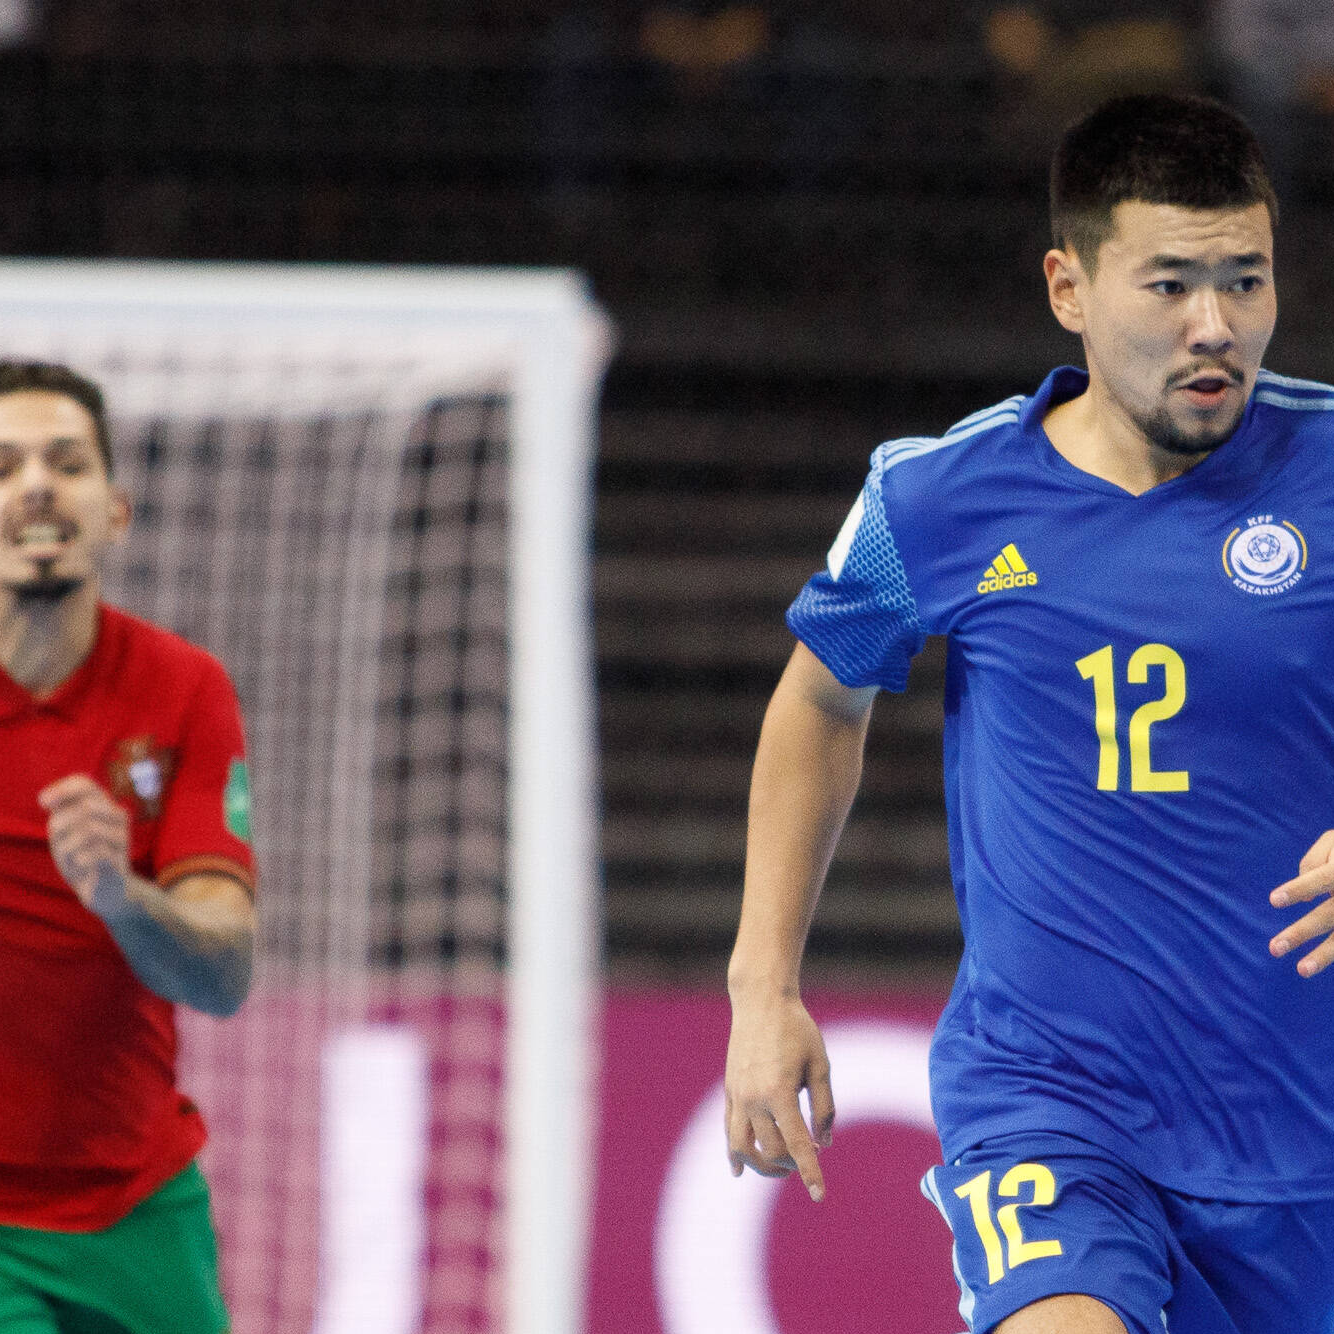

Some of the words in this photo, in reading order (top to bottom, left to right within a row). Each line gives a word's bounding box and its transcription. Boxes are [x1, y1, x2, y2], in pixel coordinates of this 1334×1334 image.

[1247, 514, 1273, 527] KFF
[977, 572, 1038, 595] adidas
[1232, 571, 1302, 596] KAZAKHSTAN
[1075, 643, 1190, 793] 12
[953, 1162, 1063, 1286] 12
